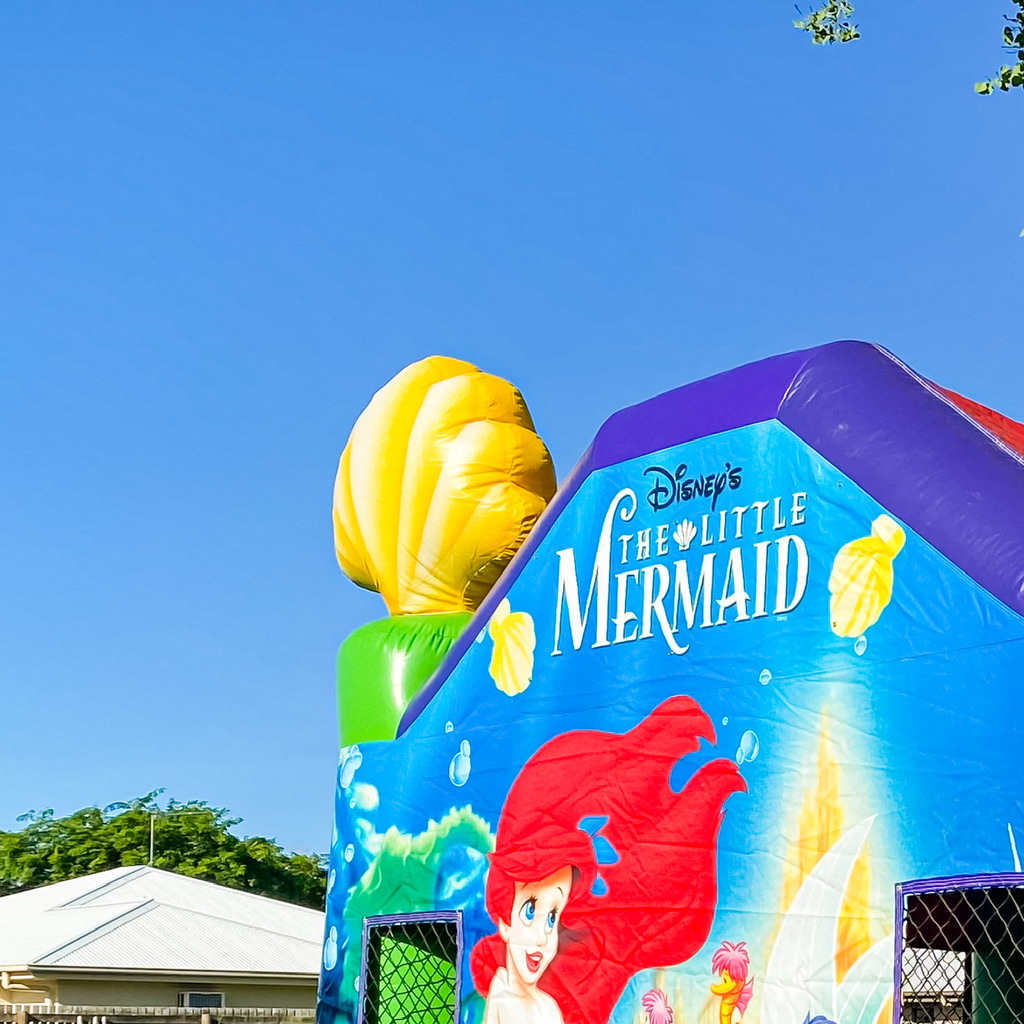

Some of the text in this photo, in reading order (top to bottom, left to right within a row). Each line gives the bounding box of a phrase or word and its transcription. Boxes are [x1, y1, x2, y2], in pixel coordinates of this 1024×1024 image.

[550, 487, 809, 657] MERMAID
[617, 491, 808, 564] THE LITTLE
